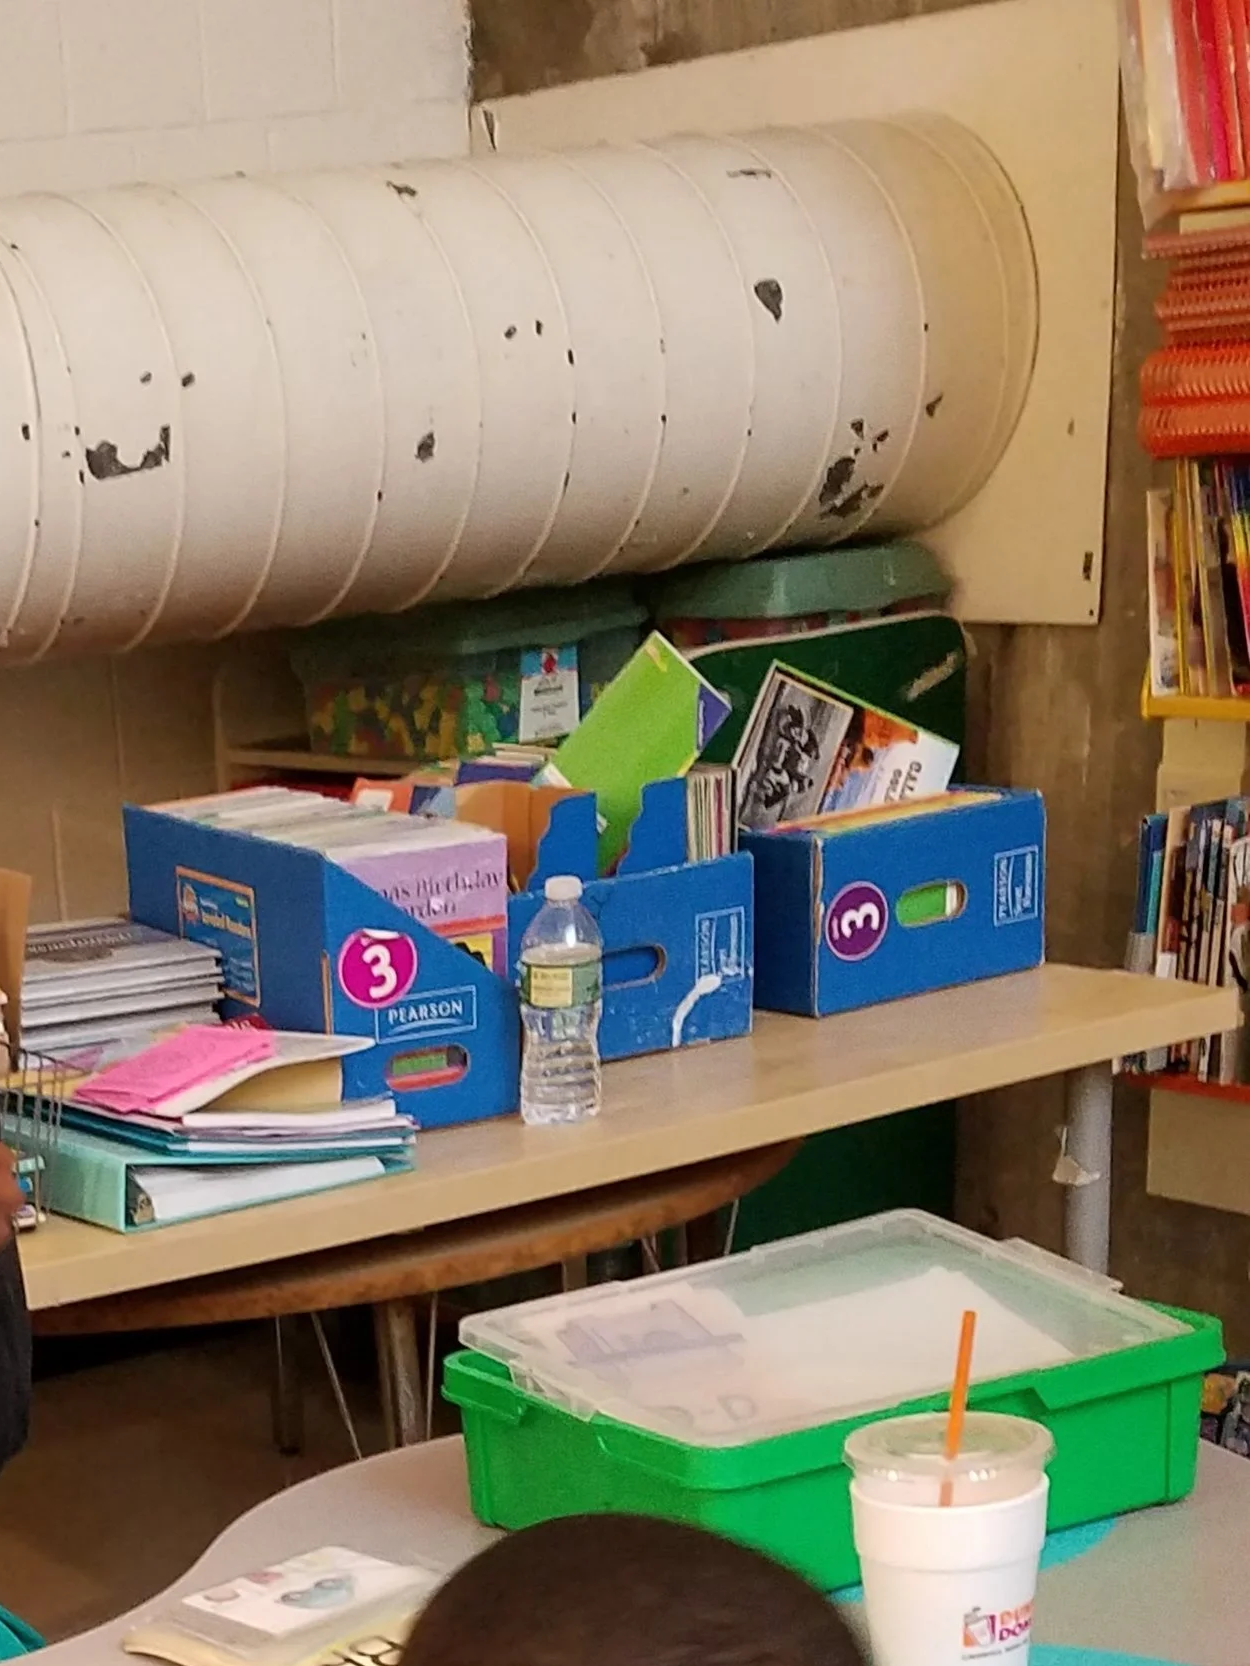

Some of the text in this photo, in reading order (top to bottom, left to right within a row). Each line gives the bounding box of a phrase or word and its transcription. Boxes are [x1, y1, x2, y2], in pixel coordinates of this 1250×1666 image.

[840, 902, 880, 938] 3
[362, 944, 397, 999] 3
[387, 1000, 463, 1025] PEARSON
